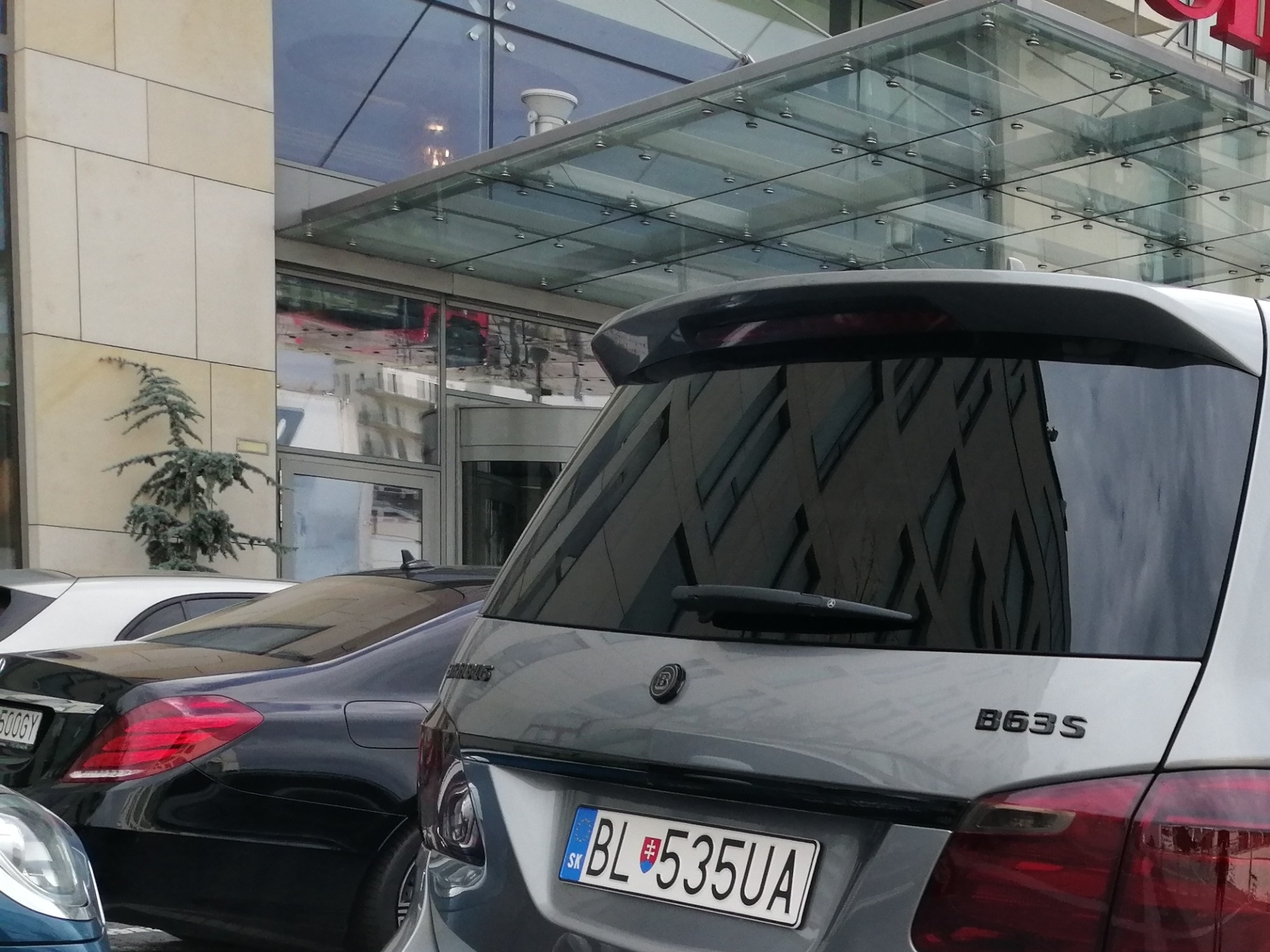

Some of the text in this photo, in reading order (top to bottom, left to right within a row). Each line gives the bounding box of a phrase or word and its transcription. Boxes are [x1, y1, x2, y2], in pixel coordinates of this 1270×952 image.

[567, 852, 583, 870] SK
[586, 818, 797, 914] BL 535UA
